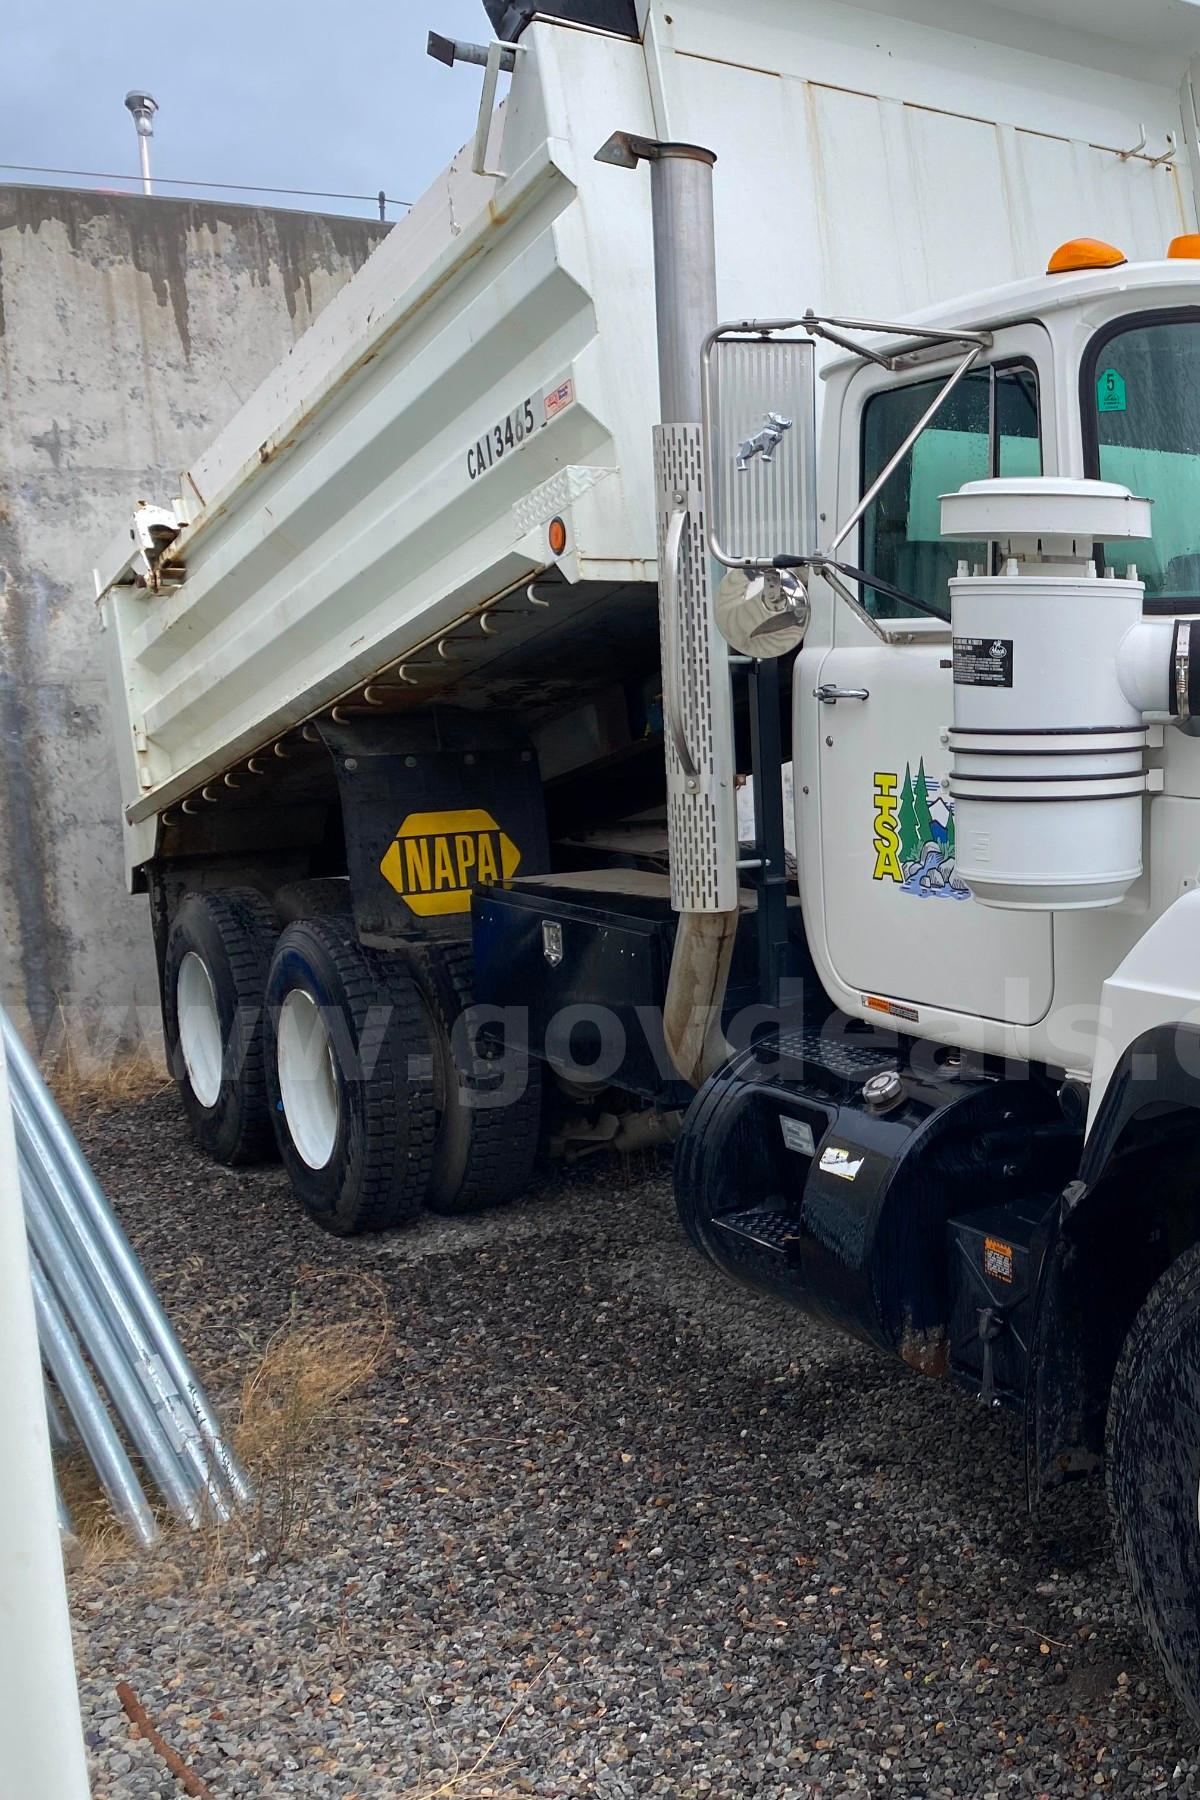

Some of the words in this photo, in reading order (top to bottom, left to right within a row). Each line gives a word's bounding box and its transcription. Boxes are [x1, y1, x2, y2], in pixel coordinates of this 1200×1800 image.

[1106, 373, 1115, 391] 5
[873, 772, 903, 883] TTSA
[404, 833, 498, 892] NAPA
